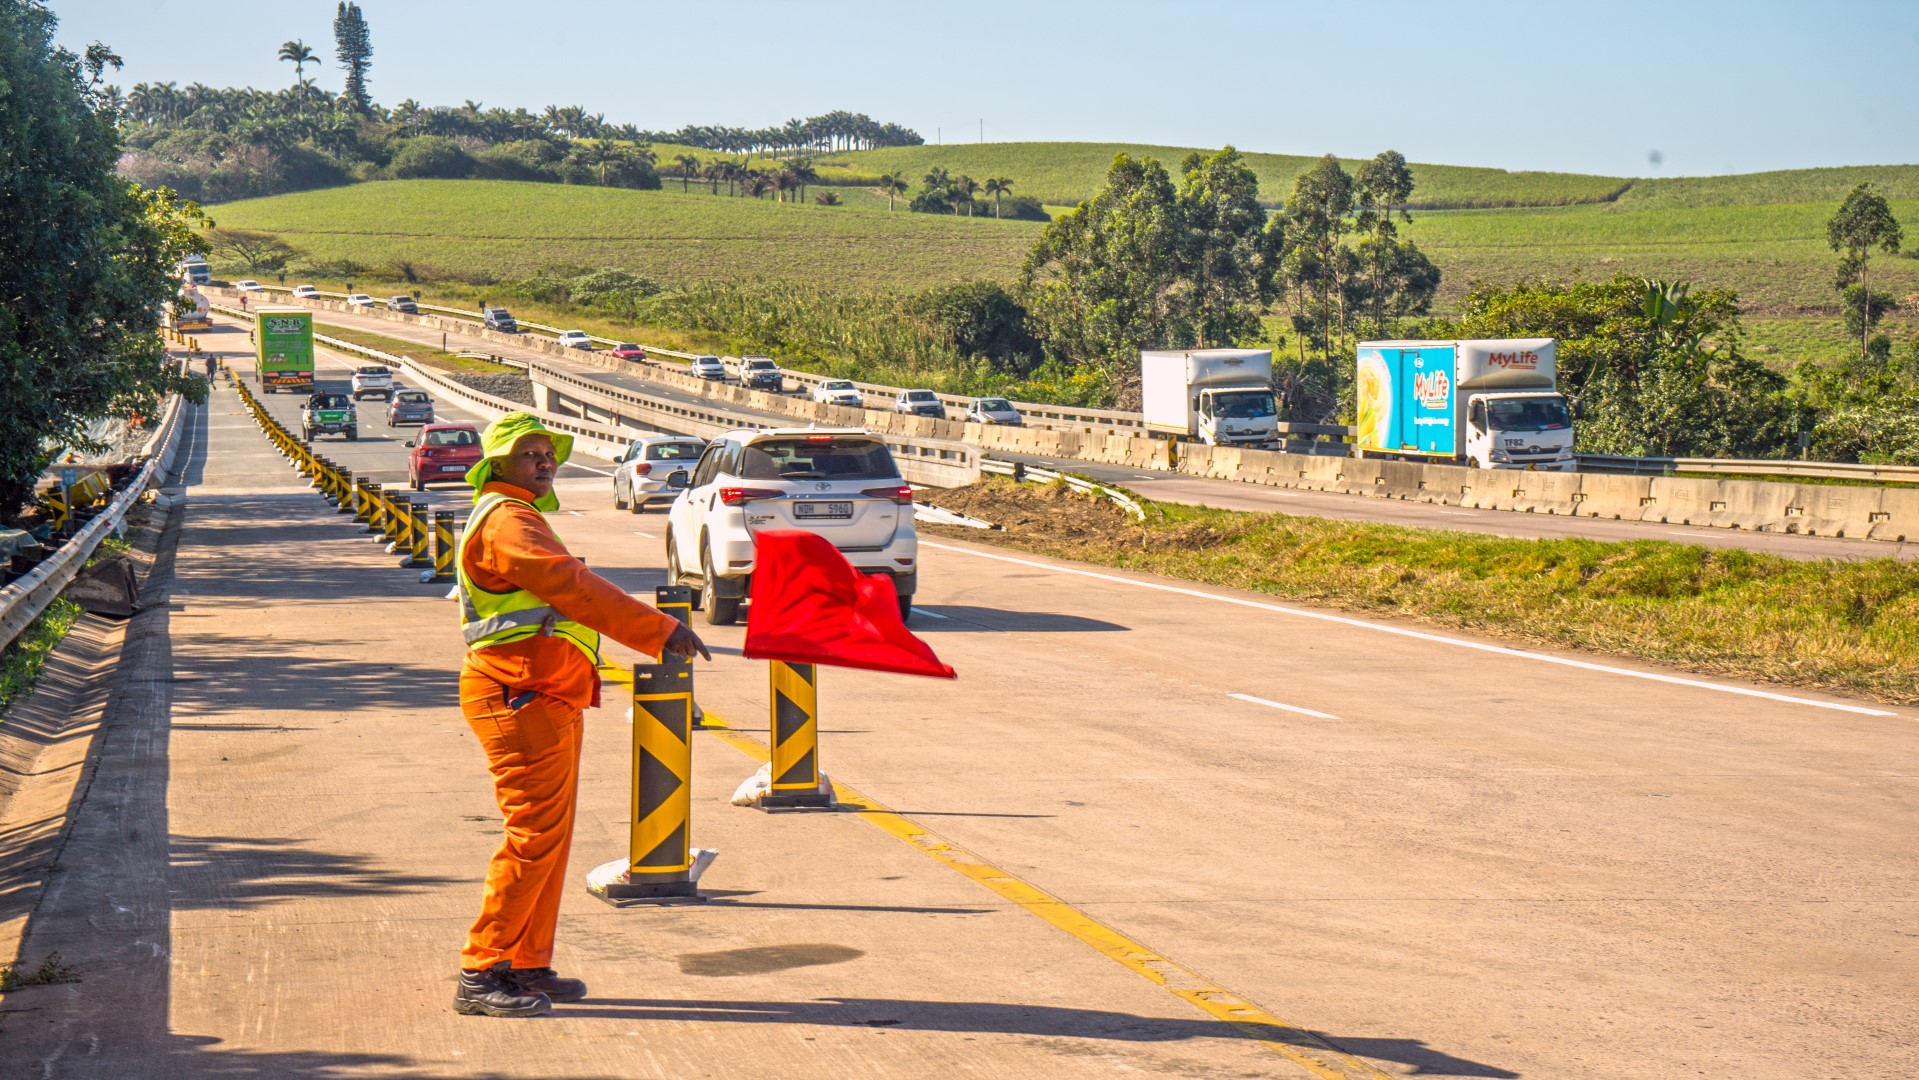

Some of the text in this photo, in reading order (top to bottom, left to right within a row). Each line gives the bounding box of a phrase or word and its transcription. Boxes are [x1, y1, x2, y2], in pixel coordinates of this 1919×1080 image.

[1488, 351, 1538, 368] MyLife
[1414, 371, 1449, 406] MyLife
[1504, 438, 1524, 447] TF82
